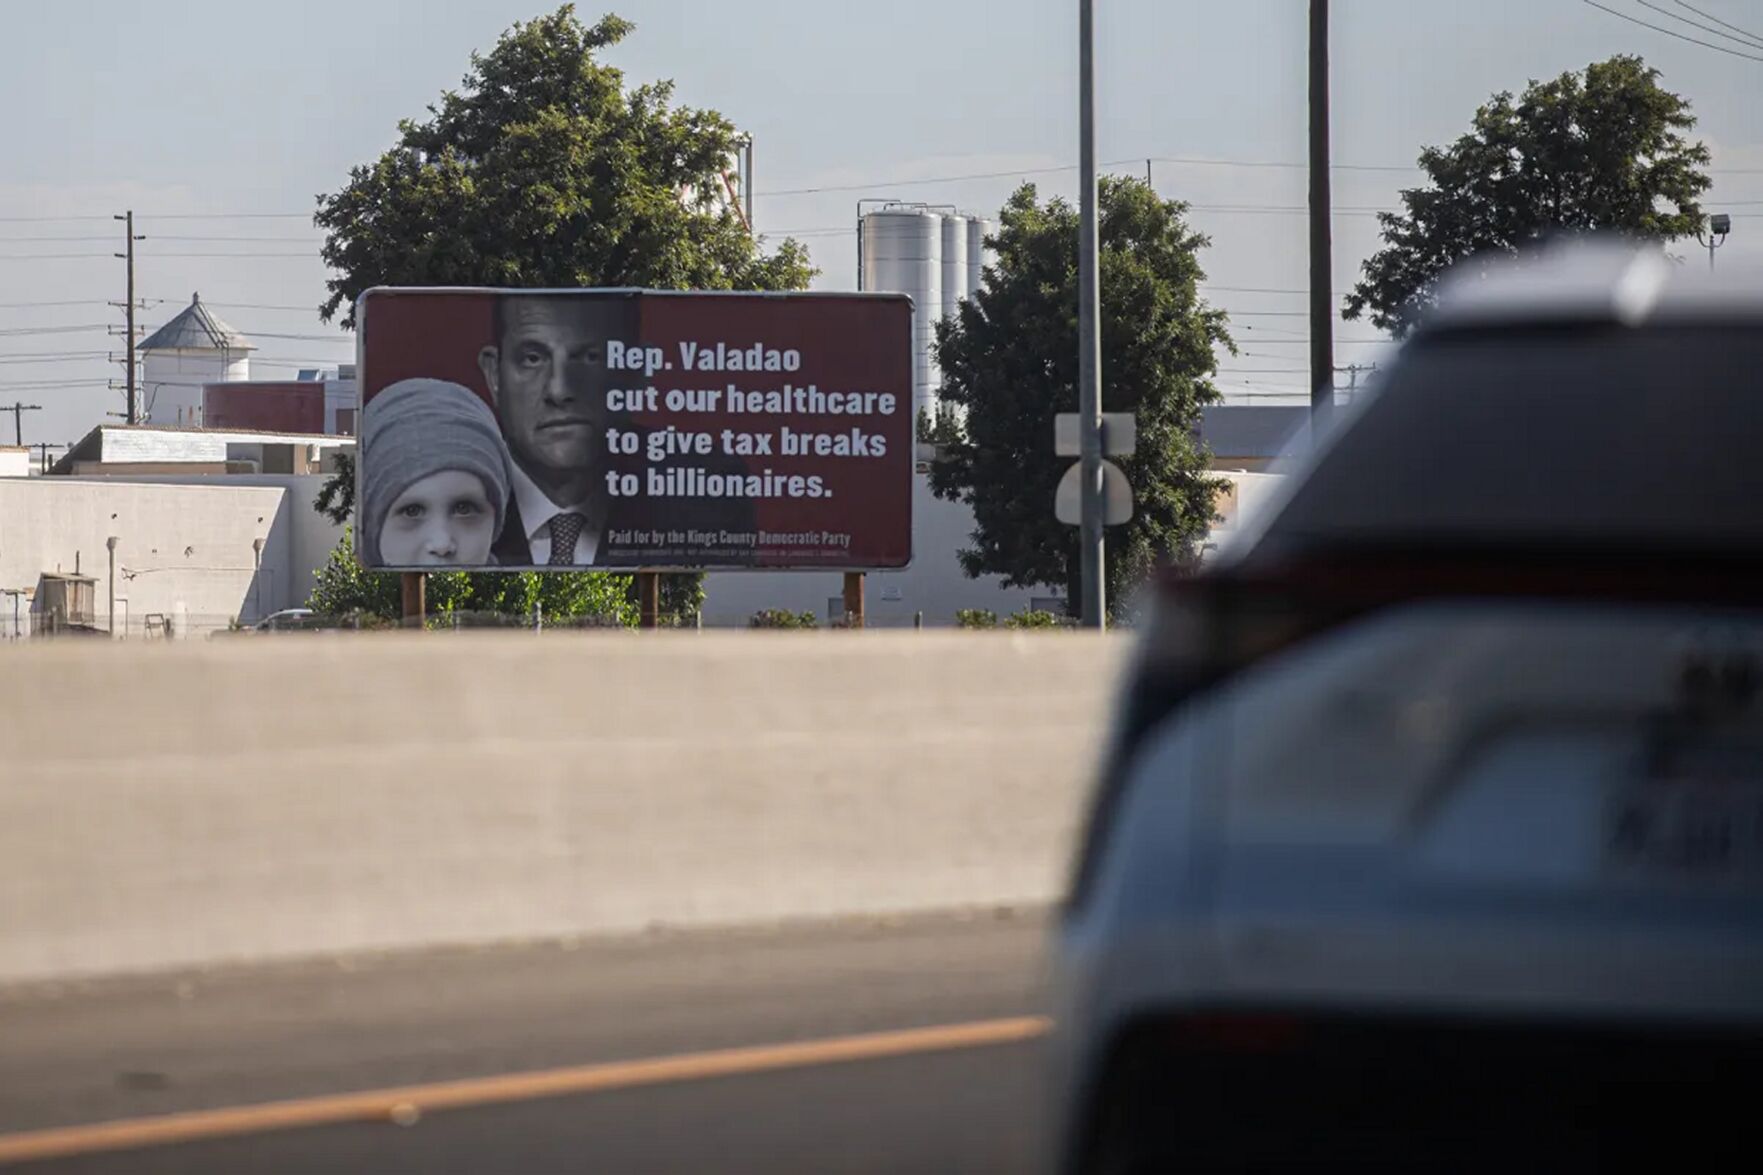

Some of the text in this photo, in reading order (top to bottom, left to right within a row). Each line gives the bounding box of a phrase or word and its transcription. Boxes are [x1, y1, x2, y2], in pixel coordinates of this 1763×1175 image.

[607, 341, 800, 376] Rep. Valadao
[606, 385, 895, 415] cut our healthcare
[606, 426, 886, 461] to give tax breaks
[606, 468, 832, 497] to billionaires.
[608, 530, 851, 548] Paid for by the Kings County Democratic Party
